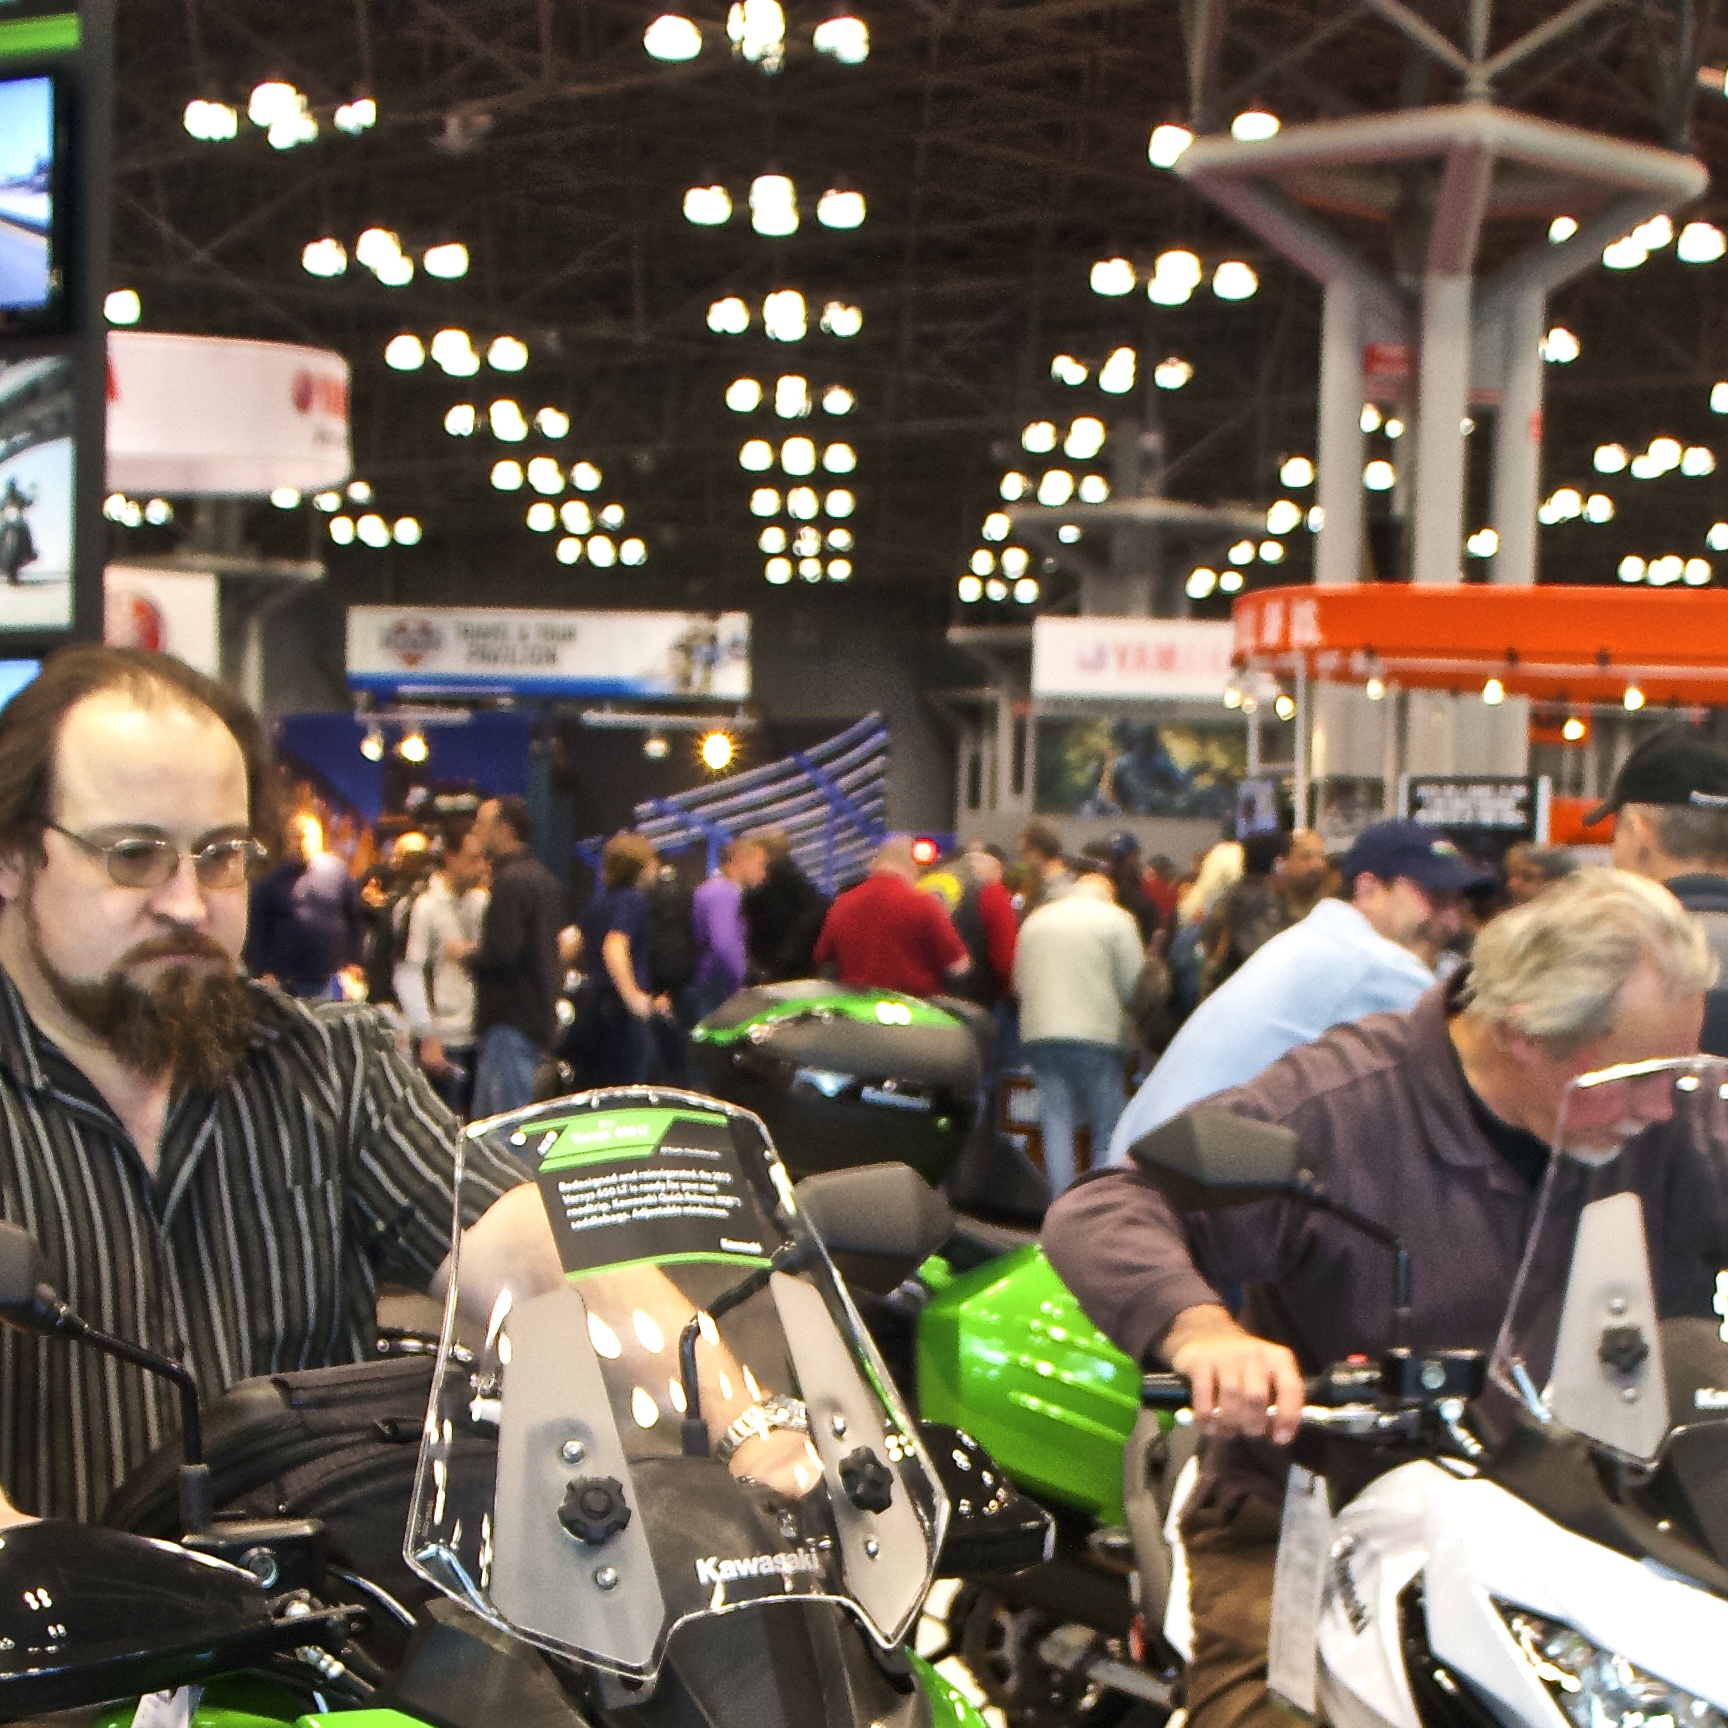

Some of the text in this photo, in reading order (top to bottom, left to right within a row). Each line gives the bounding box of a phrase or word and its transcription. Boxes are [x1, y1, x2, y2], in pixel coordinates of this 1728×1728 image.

[558, 1173, 618, 1194] Redesigned
[618, 1170, 638, 1182] and
[596, 1187, 616, 1199] 650
[616, 1184, 628, 1195] LT
[695, 1547, 821, 1586] Kawasaki
